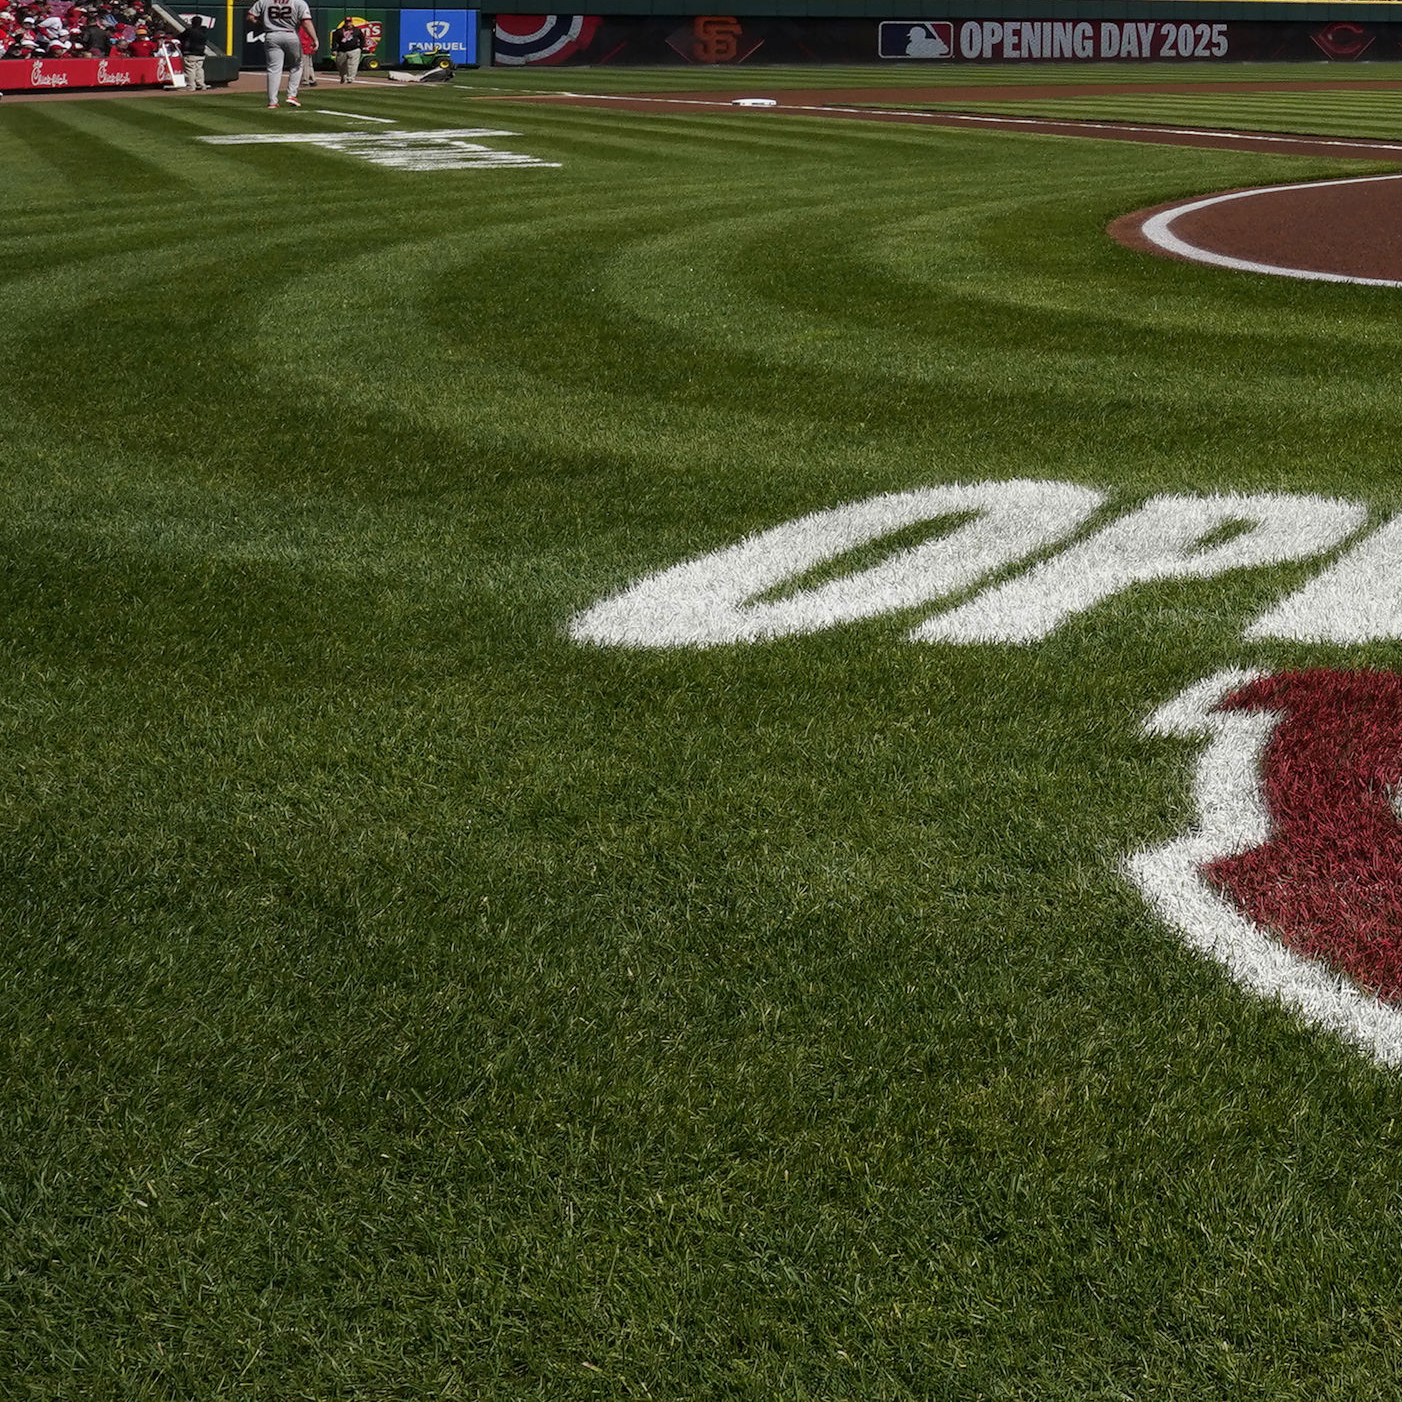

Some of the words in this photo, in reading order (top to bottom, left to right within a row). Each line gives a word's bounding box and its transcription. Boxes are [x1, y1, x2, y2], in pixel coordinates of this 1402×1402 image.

[268, 6, 292, 20] 62
[960, 21, 1093, 59] OPENING
[1100, 22, 1156, 59] DAY
[1159, 22, 1229, 58] 2025
